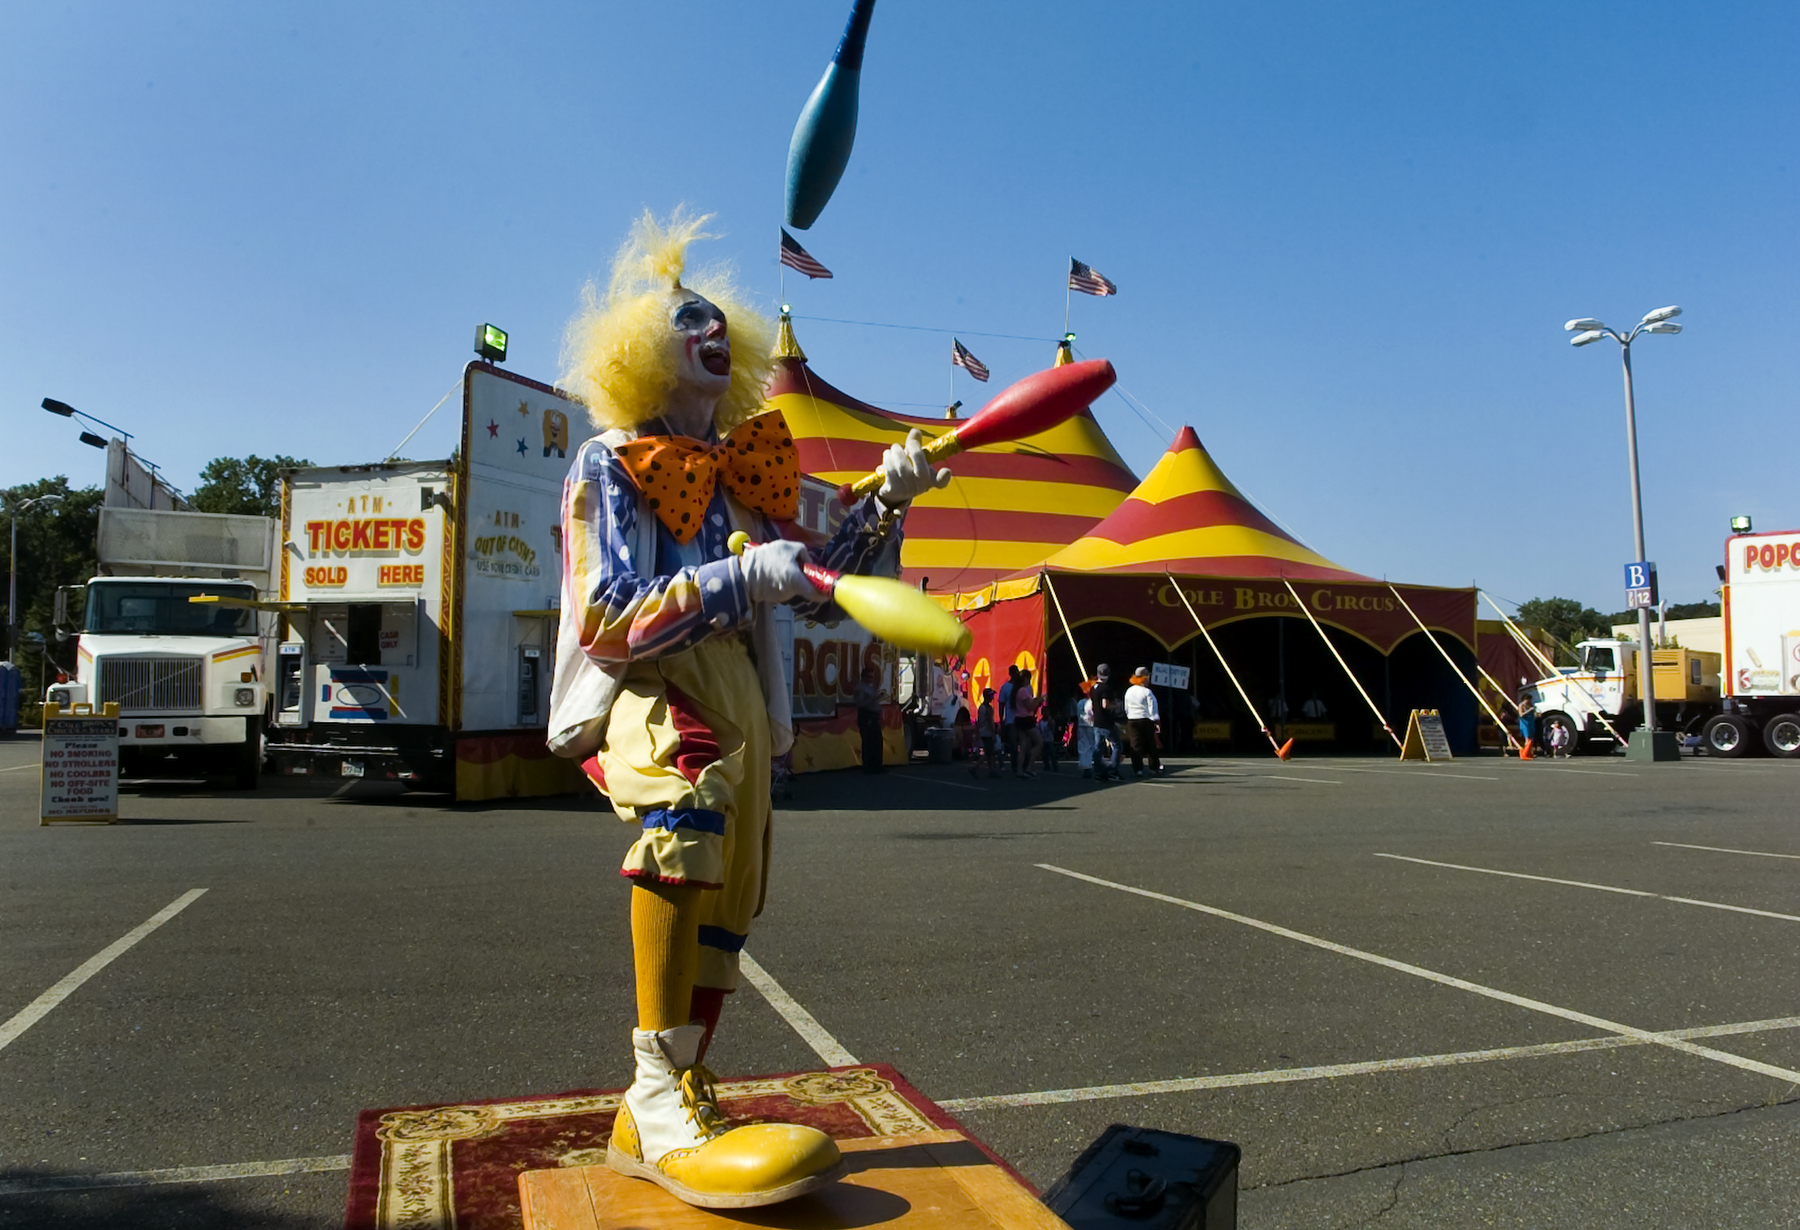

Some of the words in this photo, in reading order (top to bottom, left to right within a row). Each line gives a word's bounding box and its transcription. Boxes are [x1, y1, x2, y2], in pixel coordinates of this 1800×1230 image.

[347, 495, 384, 514] ATM
[494, 510, 519, 529] ATM
[304, 518, 426, 556] TICKETS
[474, 535, 496, 556] OUT
[496, 535, 507, 553] OF
[508, 536, 536, 566] CASH?
[304, 566, 348, 586] SOLD
[378, 564, 424, 586] HERE
[1628, 565, 1645, 587] B
[1157, 584, 1224, 607] COLE
[1311, 589, 1394, 611] CIRCUS
[1637, 592, 1650, 604] 12
[380, 631, 399, 639] CASH
[380, 641, 398, 649] ONLY
[50, 750, 64, 758] NO
[67, 750, 112, 758] SMOKING
[62, 760, 116, 768] STROLLERS
[50, 770, 64, 778] NO
[67, 770, 111, 778] COOLERS
[50, 780, 65, 788] NO
[67, 779, 110, 788] OFF-SITE
[67, 788, 93, 796] FOOD
